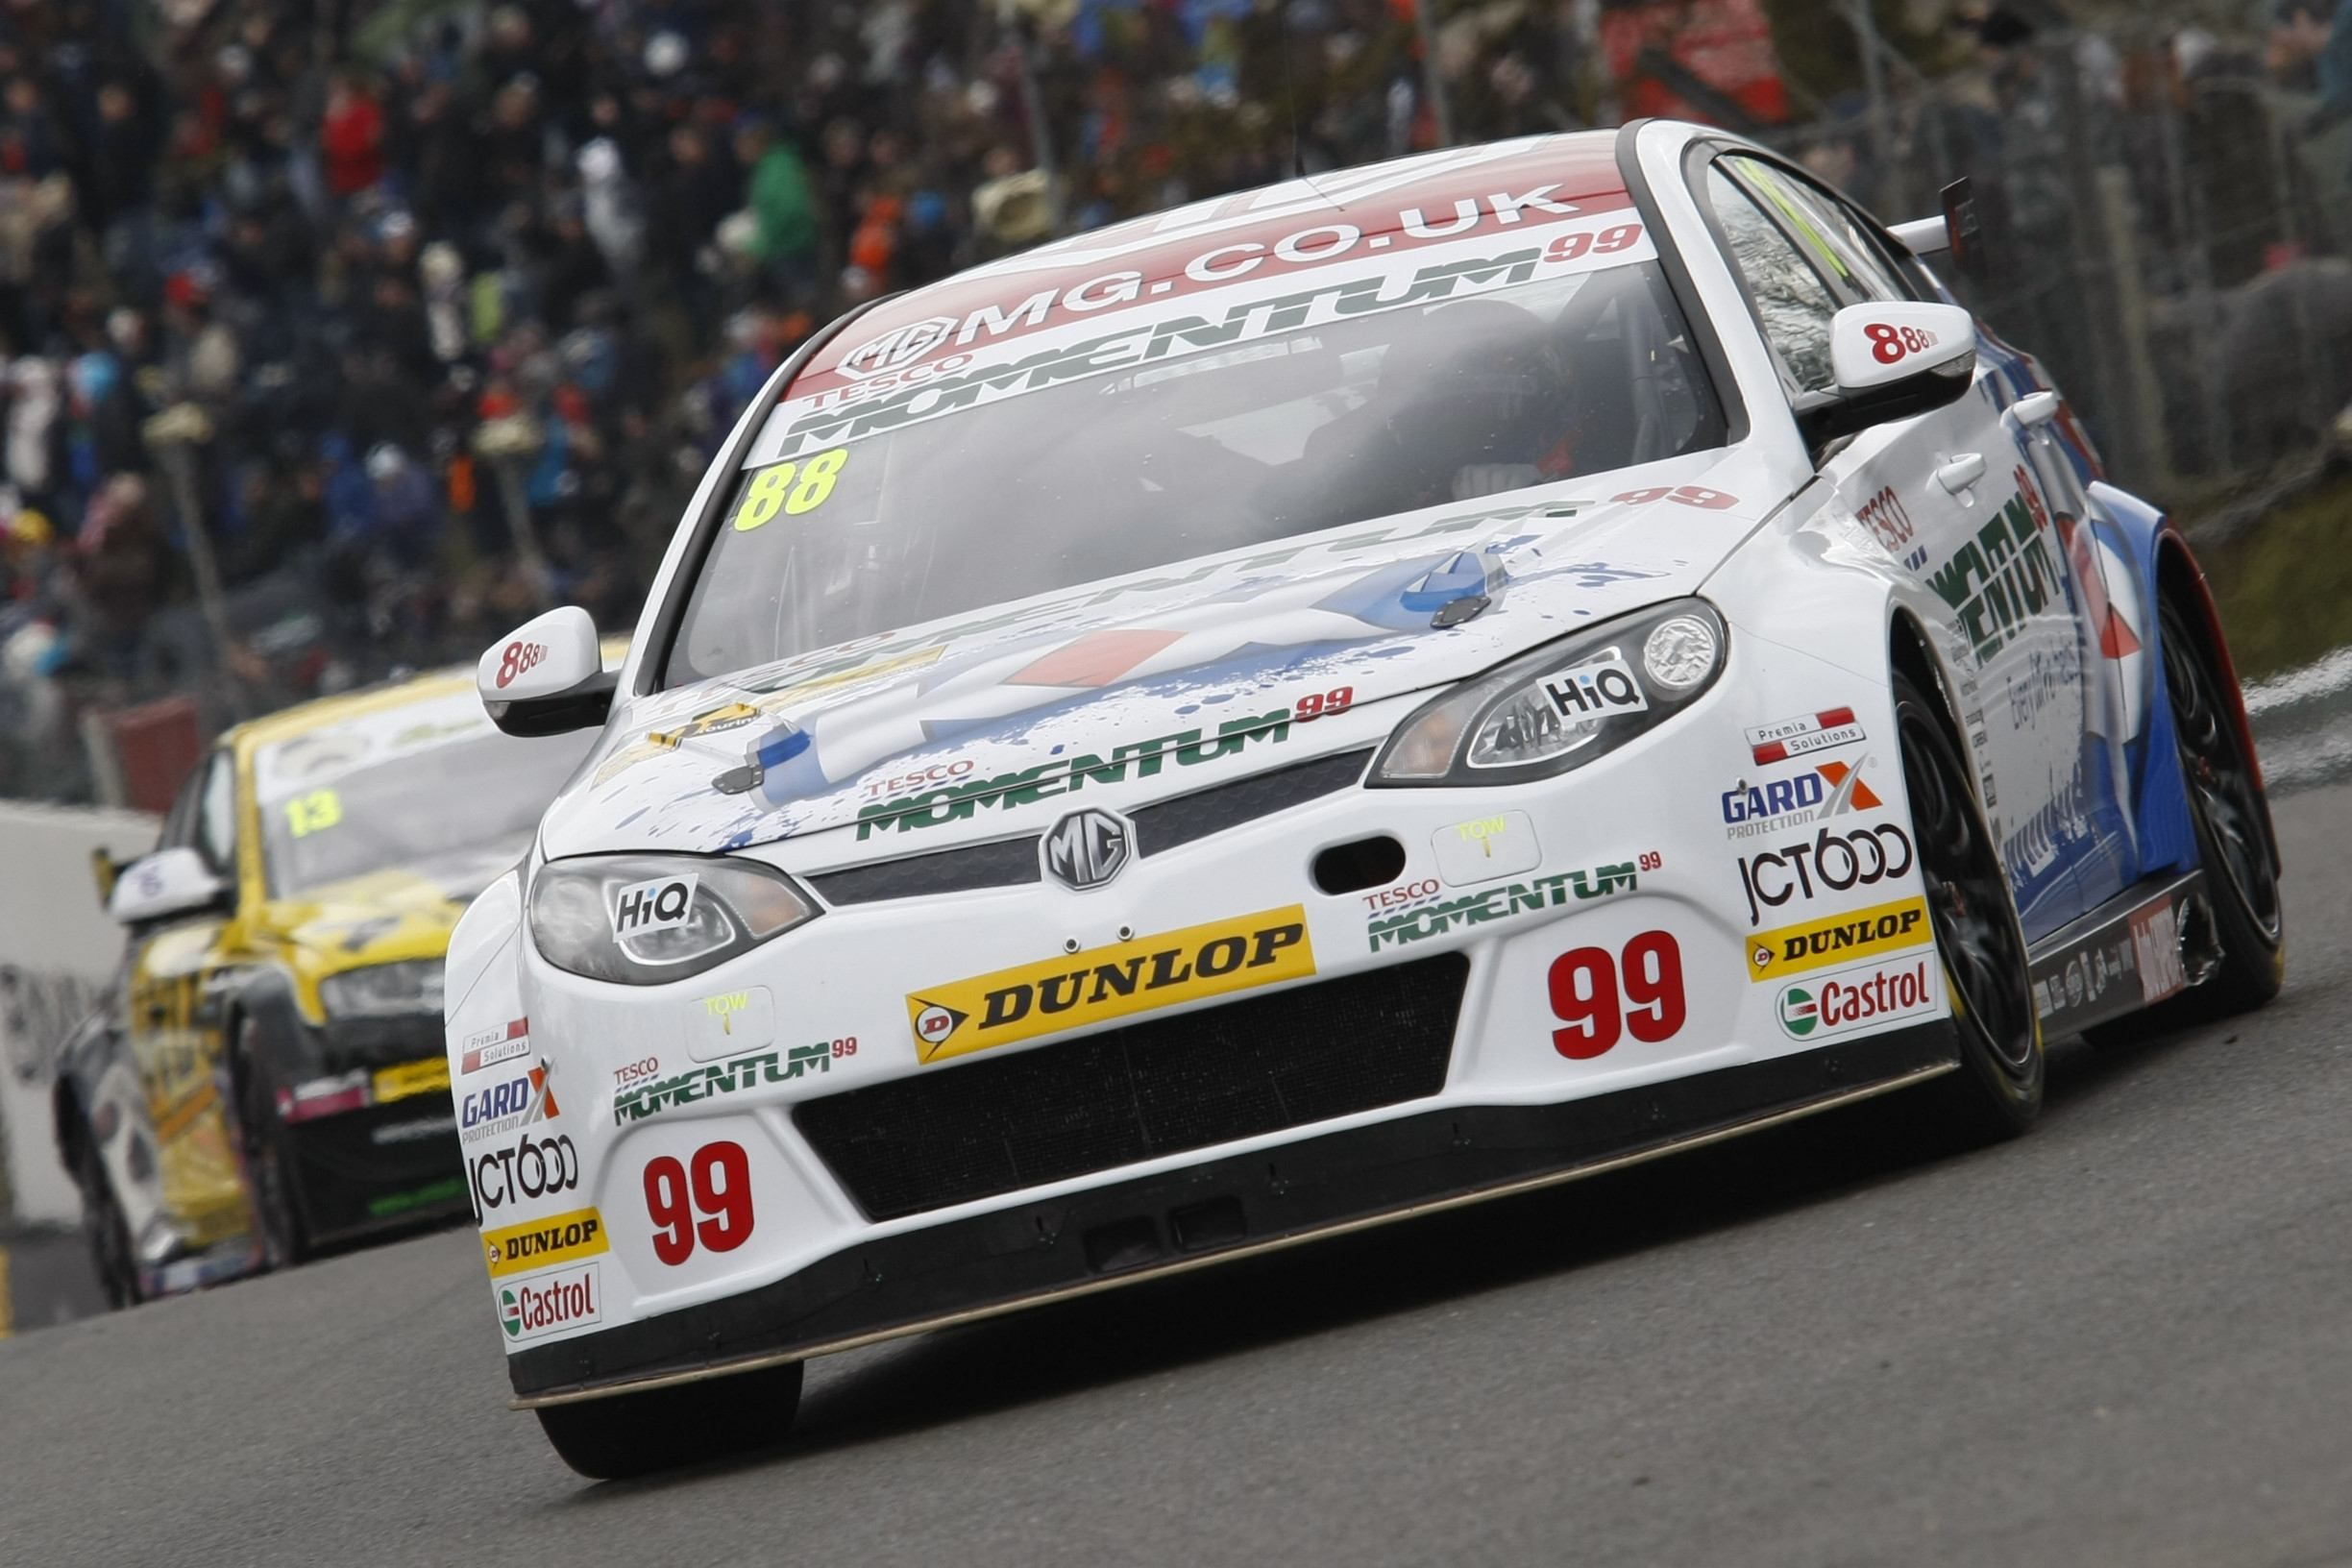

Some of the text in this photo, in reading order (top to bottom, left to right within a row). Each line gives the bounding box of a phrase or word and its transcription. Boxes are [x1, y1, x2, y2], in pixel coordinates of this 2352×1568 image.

[843, 183, 1580, 373] MG MG.CO.UK
[776, 223, 1644, 458] MOMENTUM 99
[802, 354, 973, 408] TESCO
[734, 449, 849, 531] 88
[1609, 485, 1741, 511] 99
[1545, 668, 1641, 717] HiQ
[1758, 721, 1807, 742] Premia
[1790, 727, 1856, 751] Solutions
[856, 686, 1353, 842] MOMENTUM 99
[866, 759, 974, 796] TESCO
[286, 789, 343, 839] 13
[1456, 815, 1507, 842] TOW
[1727, 809, 1814, 841] PROTECTION
[1046, 810, 1127, 885] MG
[1362, 878, 1439, 911] TESCO
[1737, 823, 1913, 926] JCT600
[617, 882, 689, 934] HiQ
[1367, 851, 1662, 953] MOMENTUM 99
[1784, 910, 1922, 962] DUNLOP
[977, 922, 1304, 1031] DUNLOP
[1548, 930, 1687, 1061] 99
[1822, 962, 1929, 1027] Castrol
[703, 992, 749, 1016] TOW
[470, 1031, 500, 1048] Premia
[483, 1041, 527, 1063] Solutions
[613, 1057, 659, 1085] TESCO
[613, 1037, 857, 1127] MOMENTUM 99
[462, 1115, 519, 1145] PROTECTION
[469, 1134, 579, 1228] JCT600
[643, 1140, 754, 1266] 99
[505, 1219, 598, 1260] DUNLOP
[521, 1273, 595, 1331] Castrol
